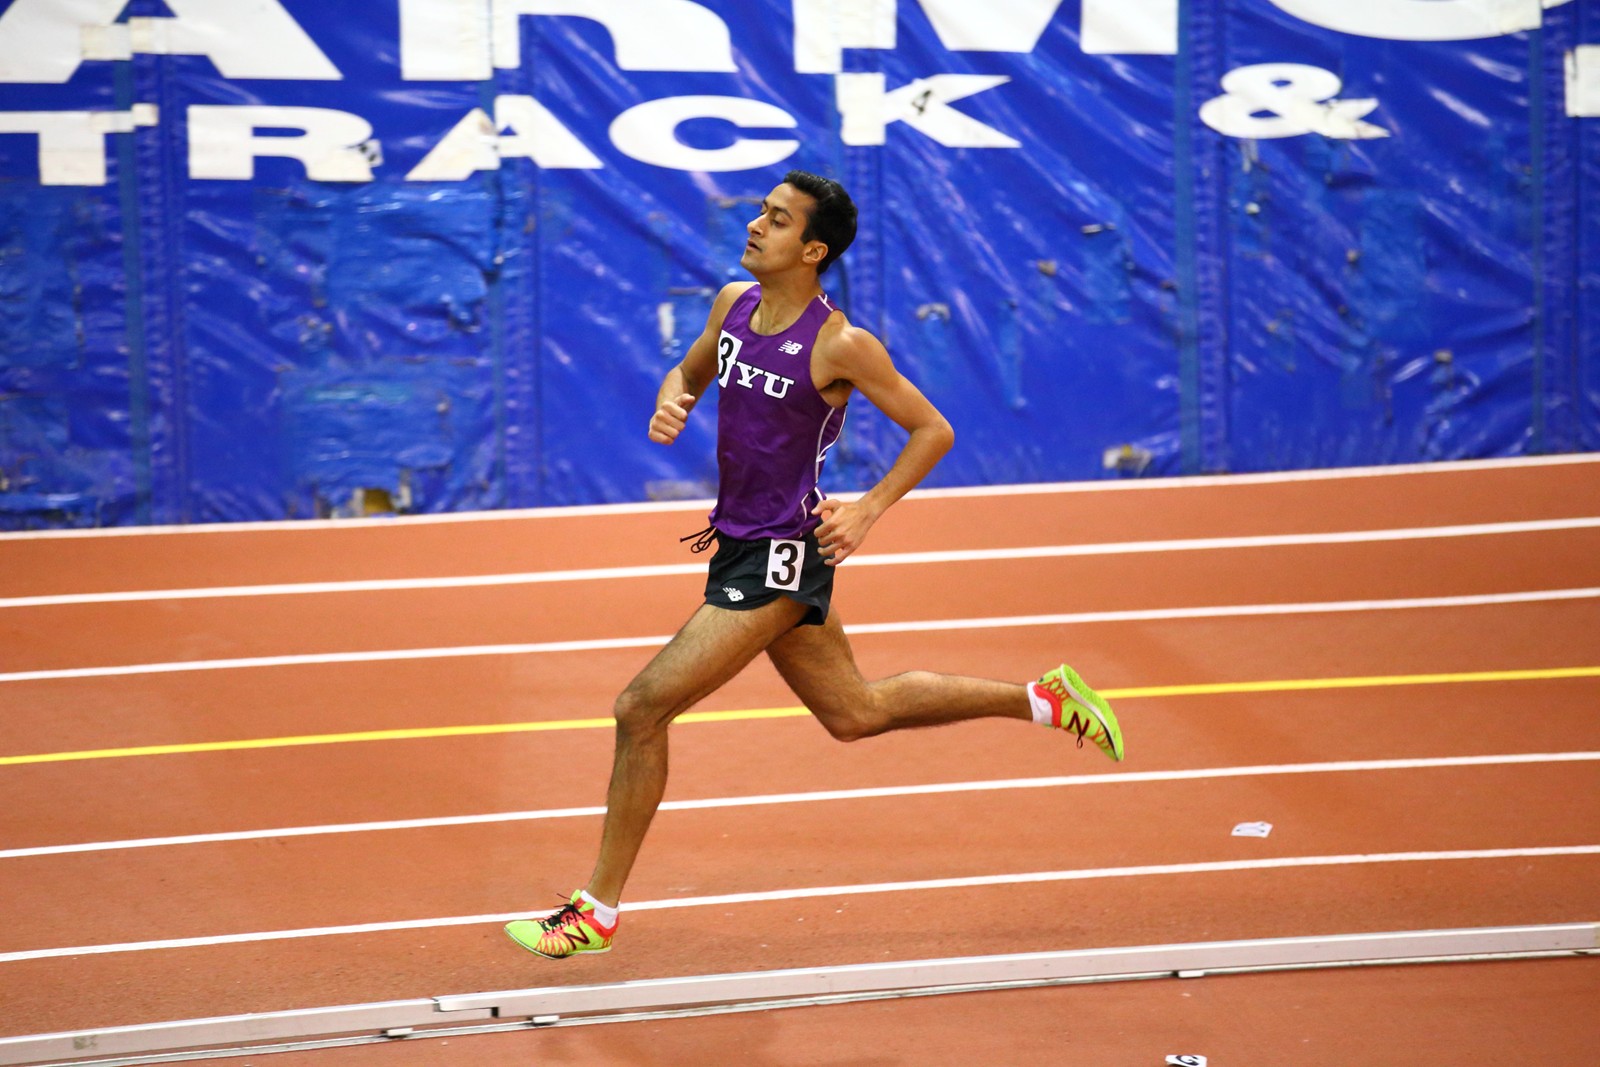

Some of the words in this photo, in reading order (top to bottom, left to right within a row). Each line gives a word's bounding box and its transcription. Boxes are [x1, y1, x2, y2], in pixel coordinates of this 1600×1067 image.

[0, 72, 1022, 187] TRACK
[1199, 62, 1391, 140] &
[718, 336, 734, 380] 3
[732, 359, 795, 399] YU
[771, 542, 799, 586] 3
[563, 926, 590, 951] N
